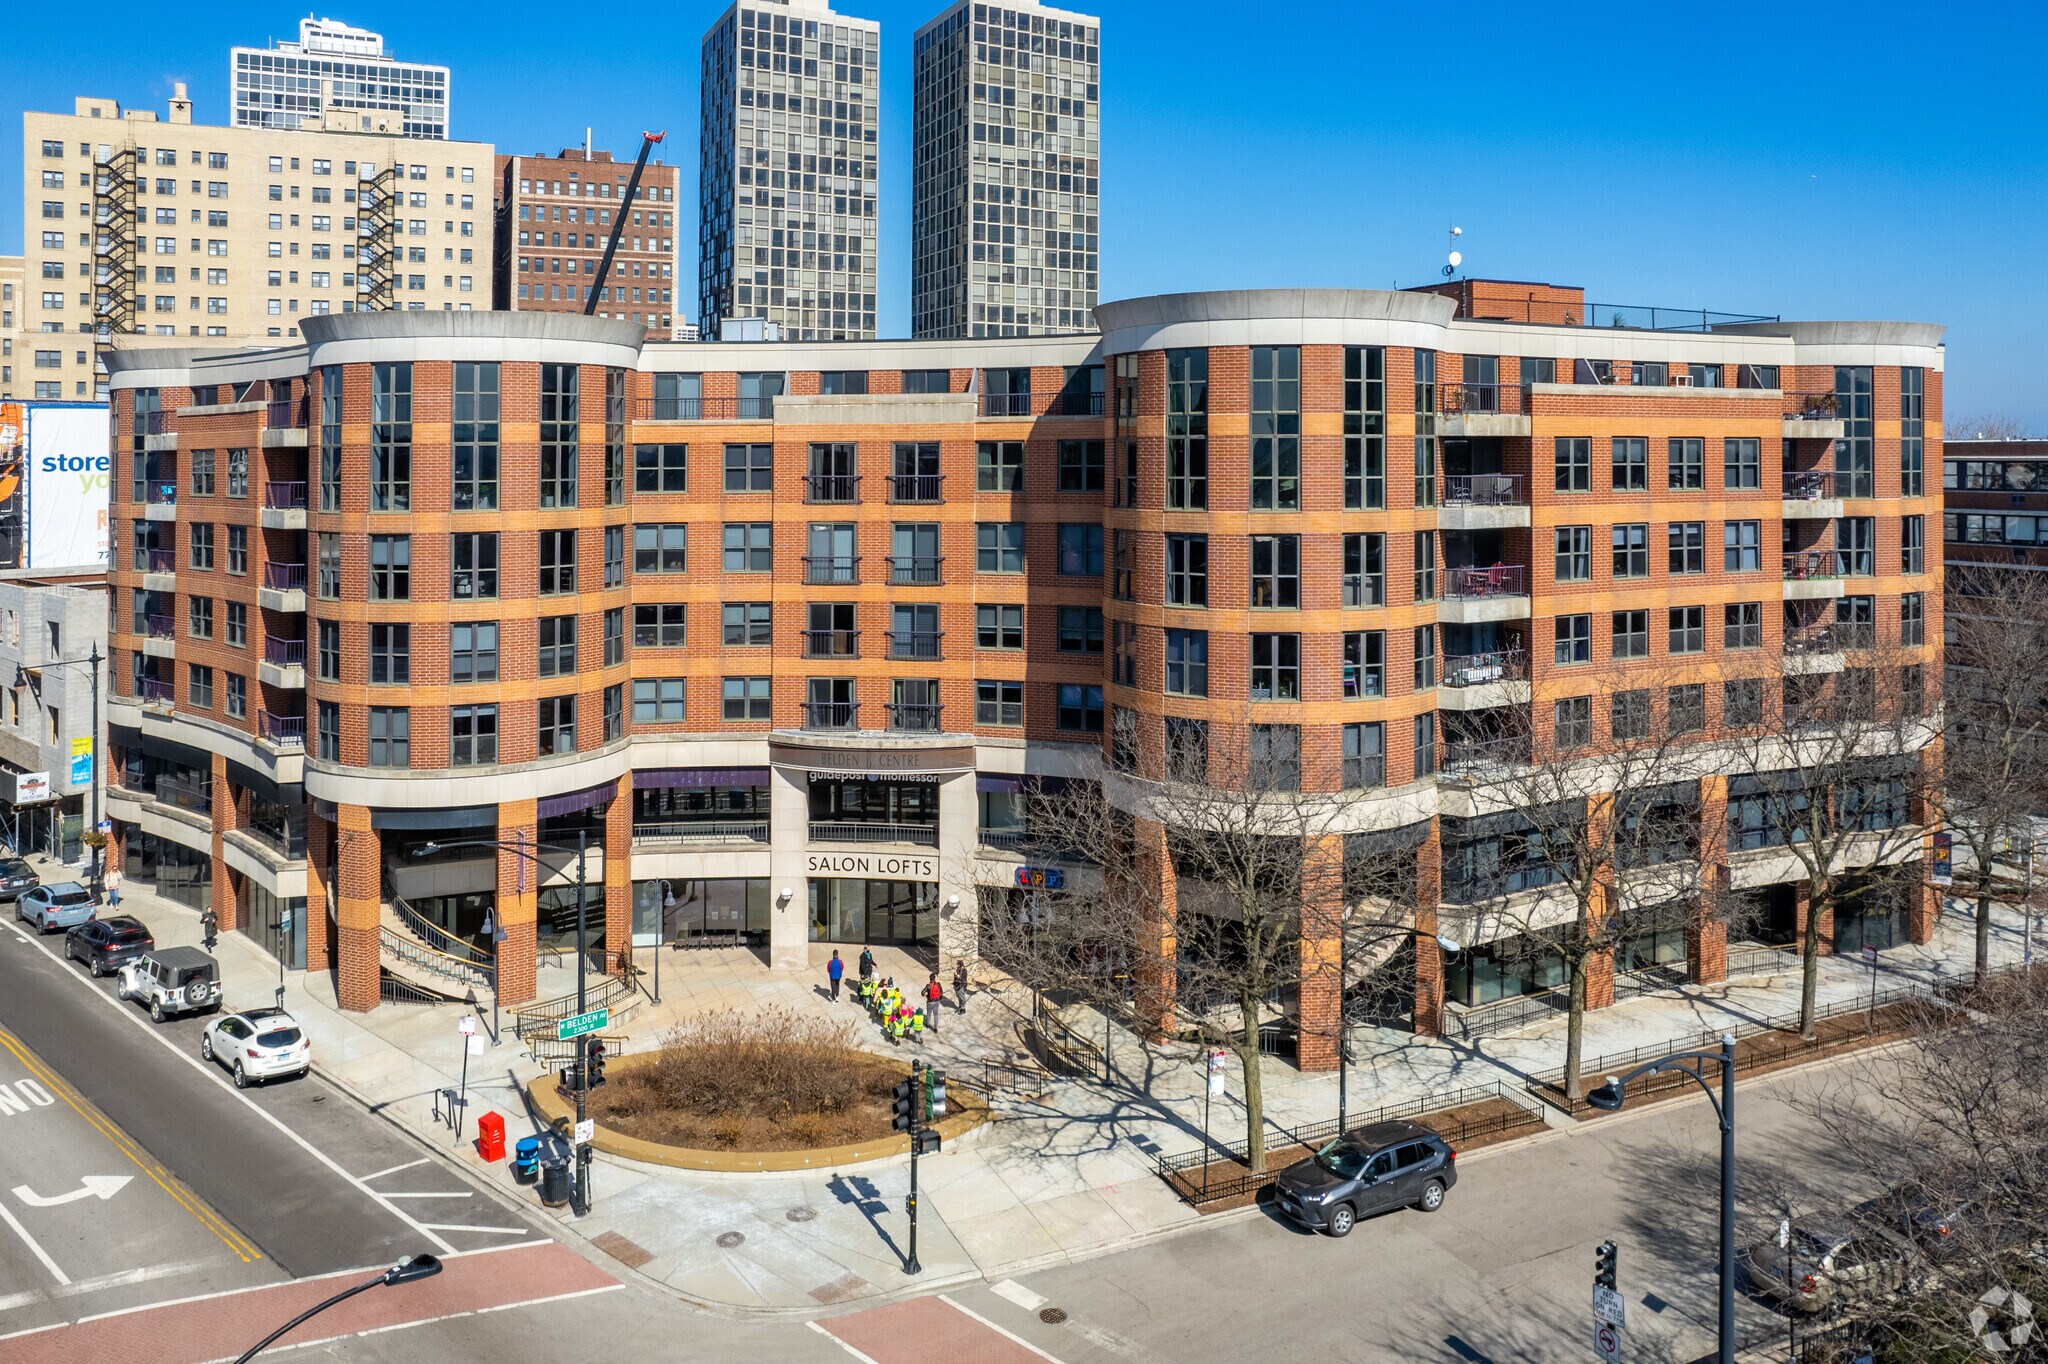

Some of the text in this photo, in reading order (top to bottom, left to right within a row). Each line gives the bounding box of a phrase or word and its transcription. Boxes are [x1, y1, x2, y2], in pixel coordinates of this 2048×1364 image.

[42, 454, 109, 472] store
[821, 753, 859, 766] BELDEN
[879, 754, 920, 767] CENTRE
[809, 857, 931, 875] SALON LOFTS
[567, 1014, 598, 1029] BELDEN
[573, 1025, 588, 1034] 2300
[1602, 1290, 1614, 1300] NO
[1600, 1296, 1618, 1309] TURN
[1596, 1302, 1622, 1318] ON RED
